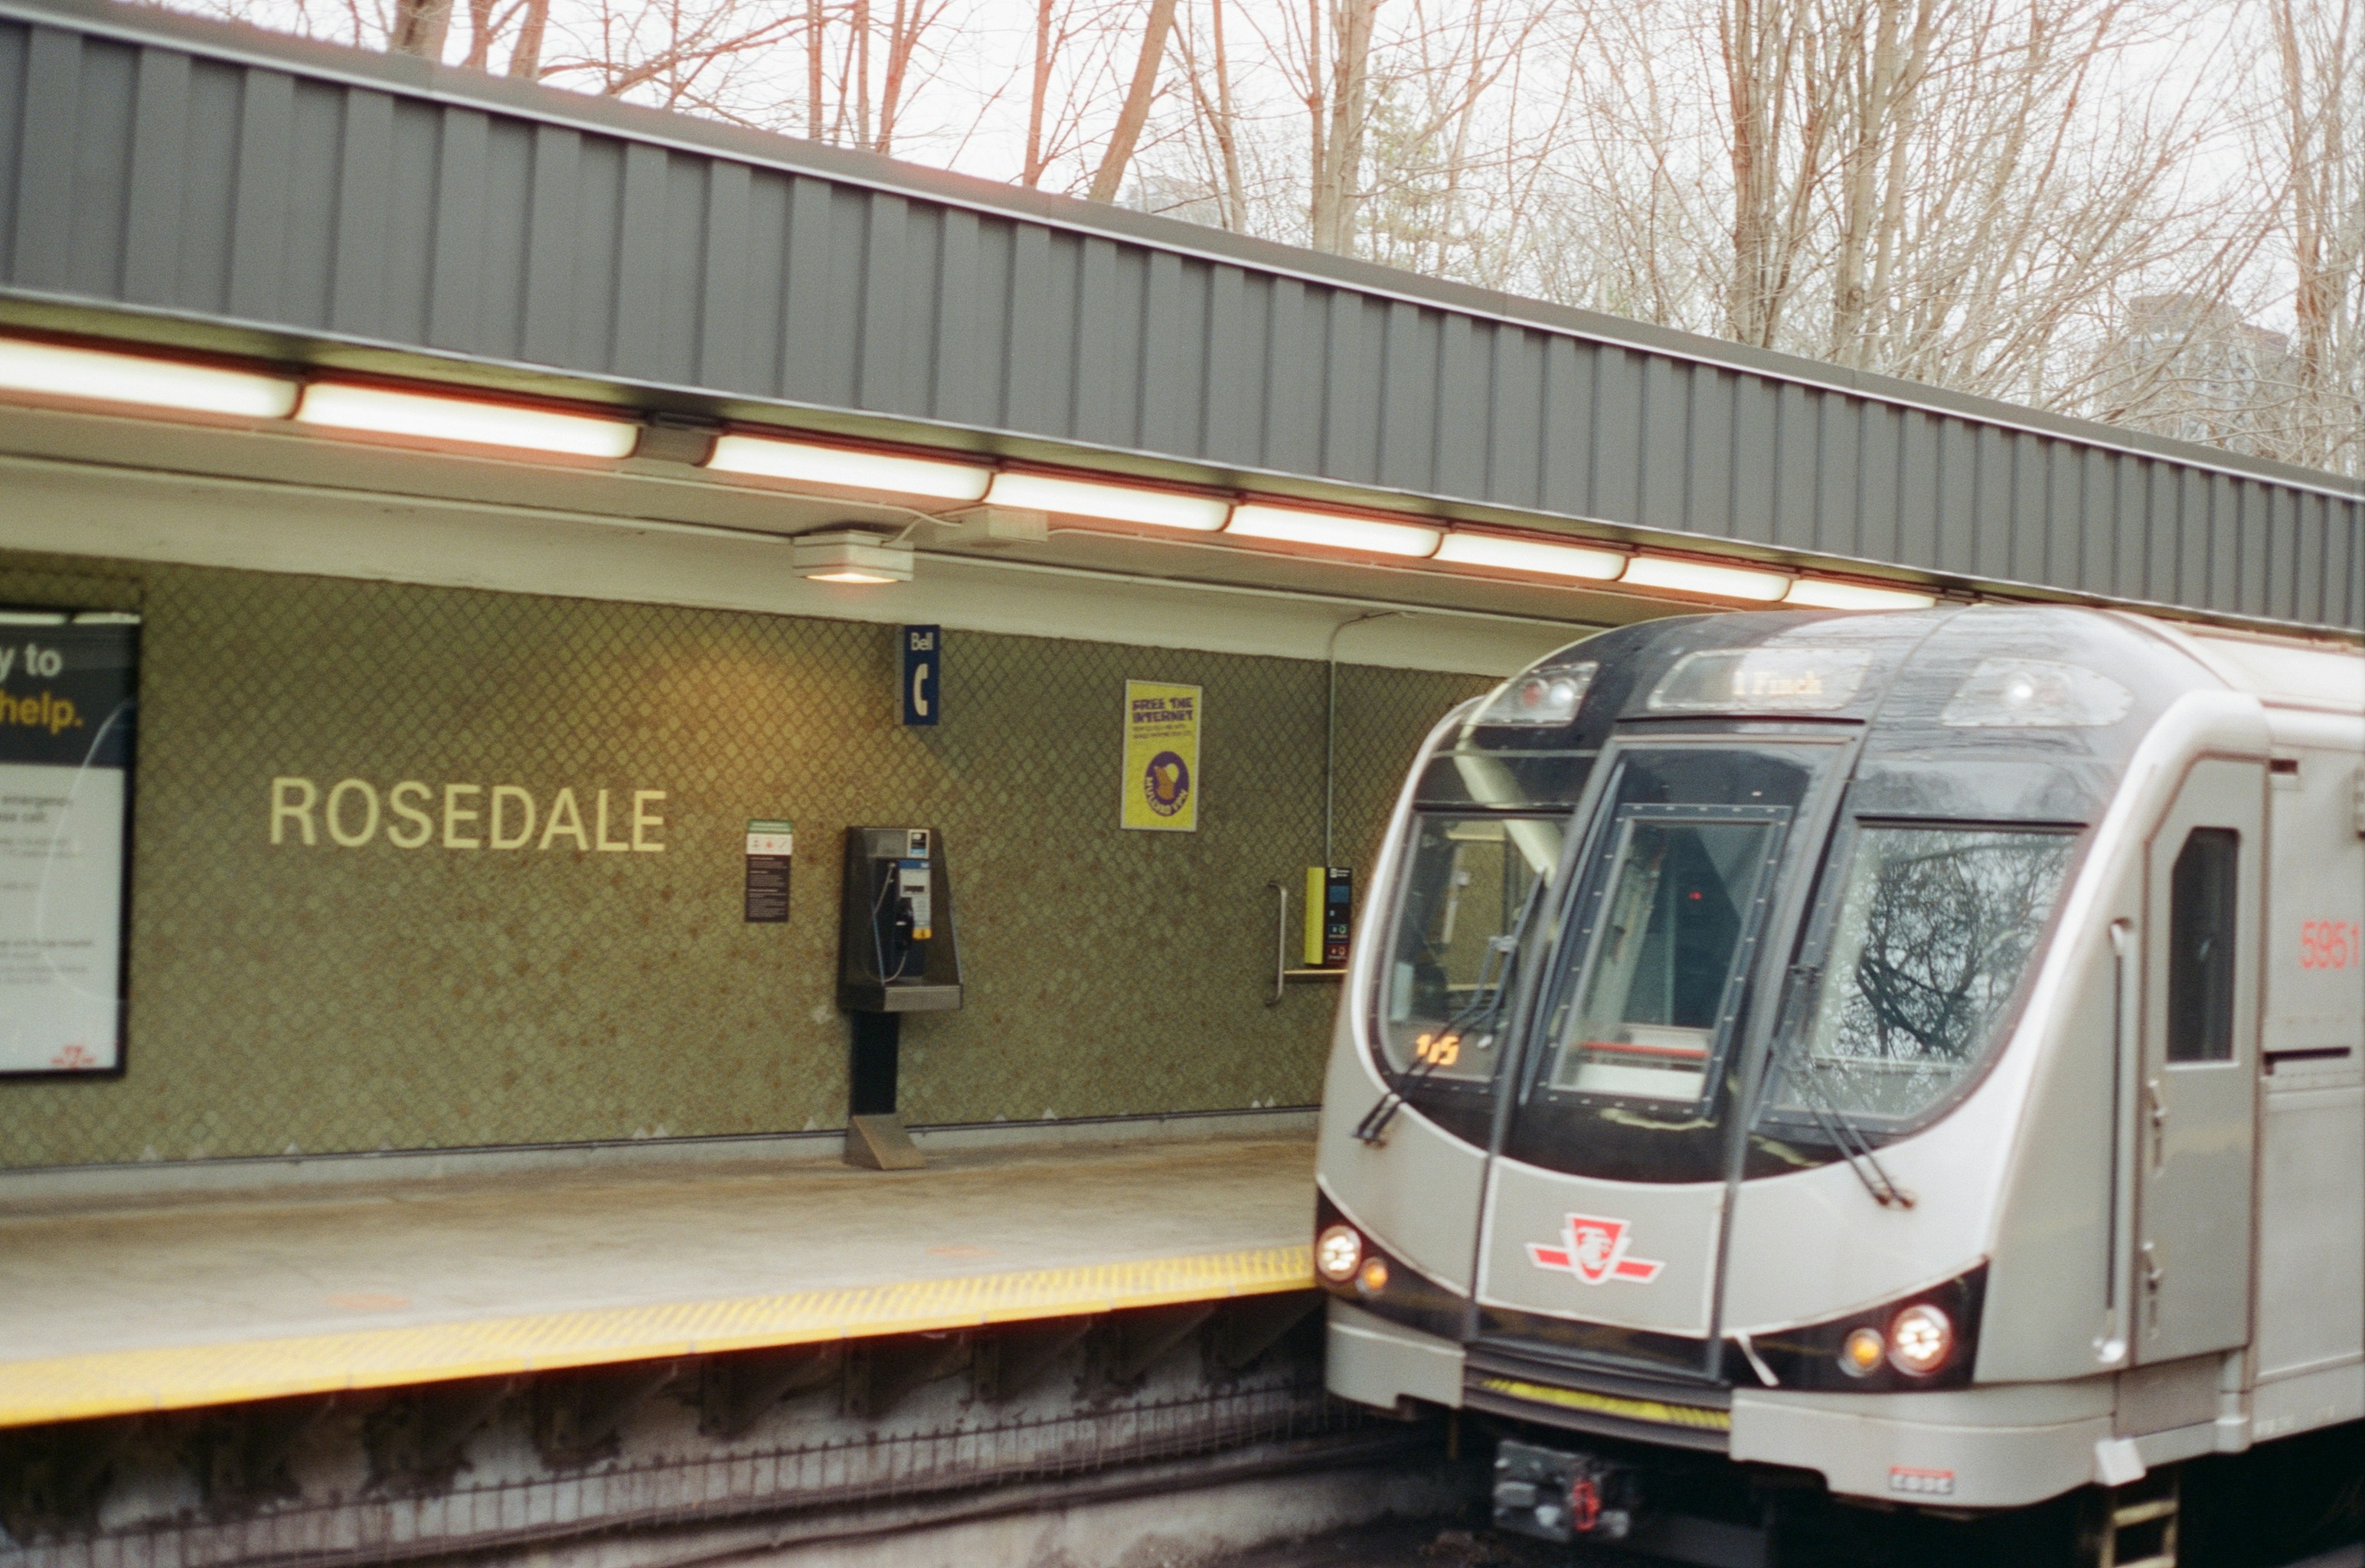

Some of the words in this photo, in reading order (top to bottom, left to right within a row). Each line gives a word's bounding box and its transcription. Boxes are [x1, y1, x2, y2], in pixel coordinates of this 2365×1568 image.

[911, 632, 933, 651] Bell
[25, 642, 63, 678] to
[0, 690, 83, 736] help.
[1132, 698, 1165, 710] FREE
[1169, 697, 1193, 708] THE
[1132, 710, 1193, 724] INTERNET
[270, 777, 667, 852] ROSEDALE
[2300, 921, 2360, 969] 5951
